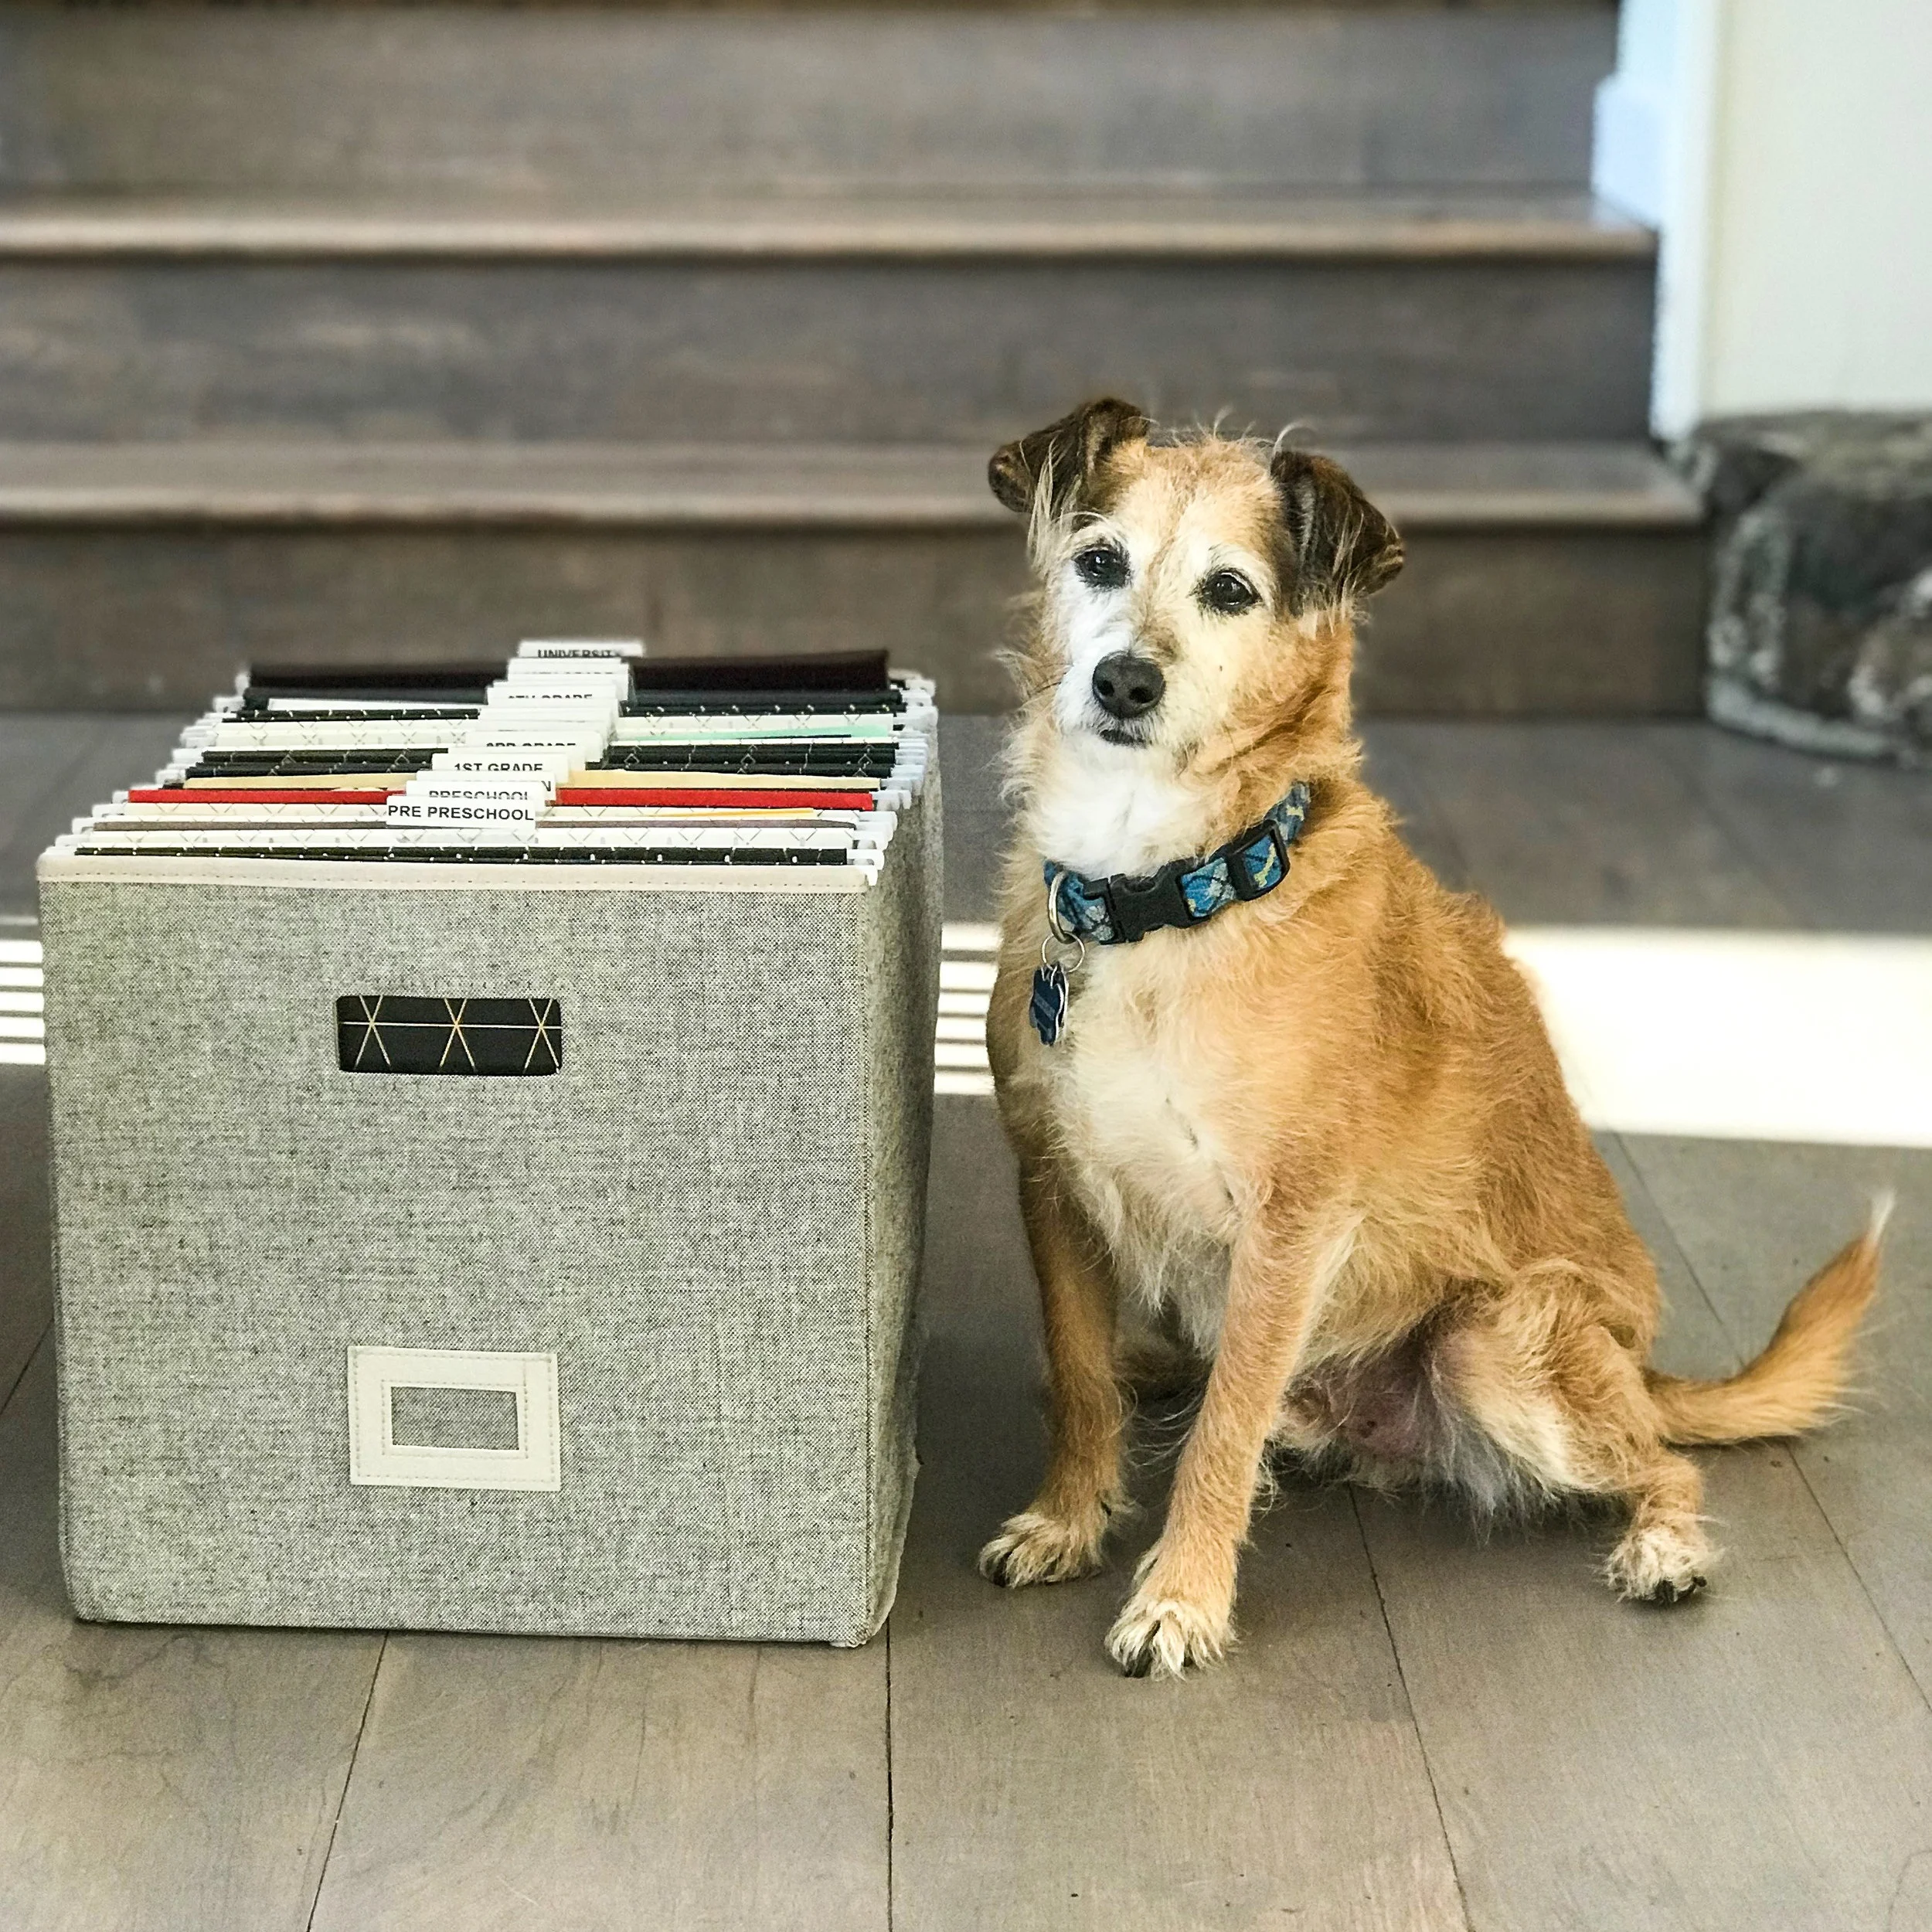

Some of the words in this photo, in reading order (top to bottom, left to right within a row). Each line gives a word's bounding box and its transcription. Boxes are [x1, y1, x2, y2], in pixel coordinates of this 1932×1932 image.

[454, 763, 483, 771] 1ST
[488, 763, 543, 771] GRADE
[429, 790, 528, 800] PRESCHOOL
[388, 804, 421, 818] PRE
[427, 806, 534, 821] PRESCHOOL
